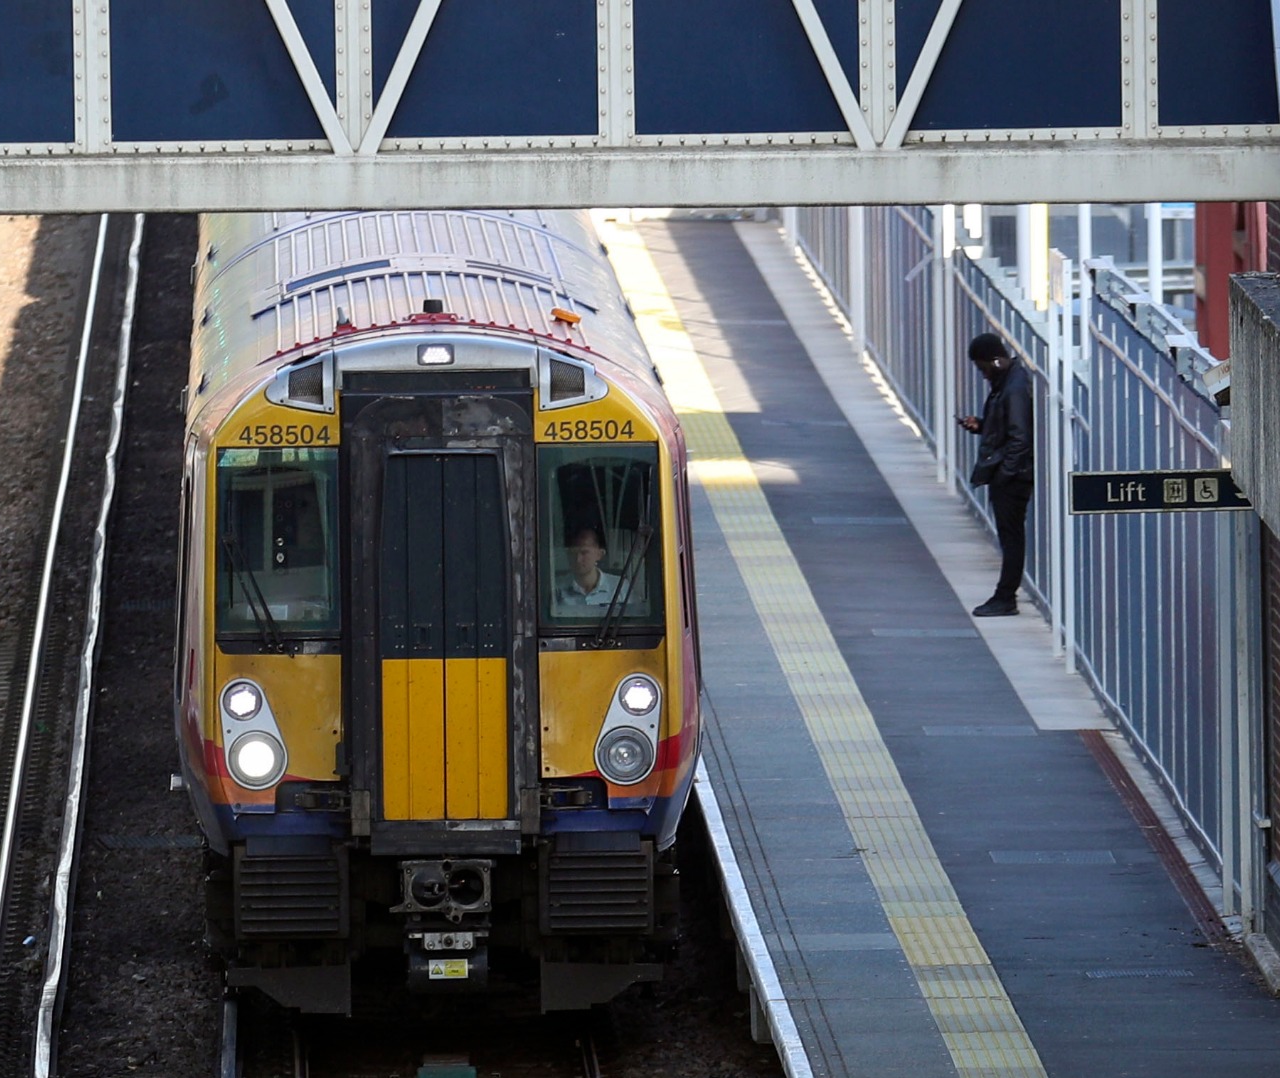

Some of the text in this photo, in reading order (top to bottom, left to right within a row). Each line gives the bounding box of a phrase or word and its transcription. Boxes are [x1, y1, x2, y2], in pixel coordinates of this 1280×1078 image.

[238, 424, 331, 445] 458504
[543, 420, 635, 441] 458504
[1106, 481, 1147, 503] Lift
